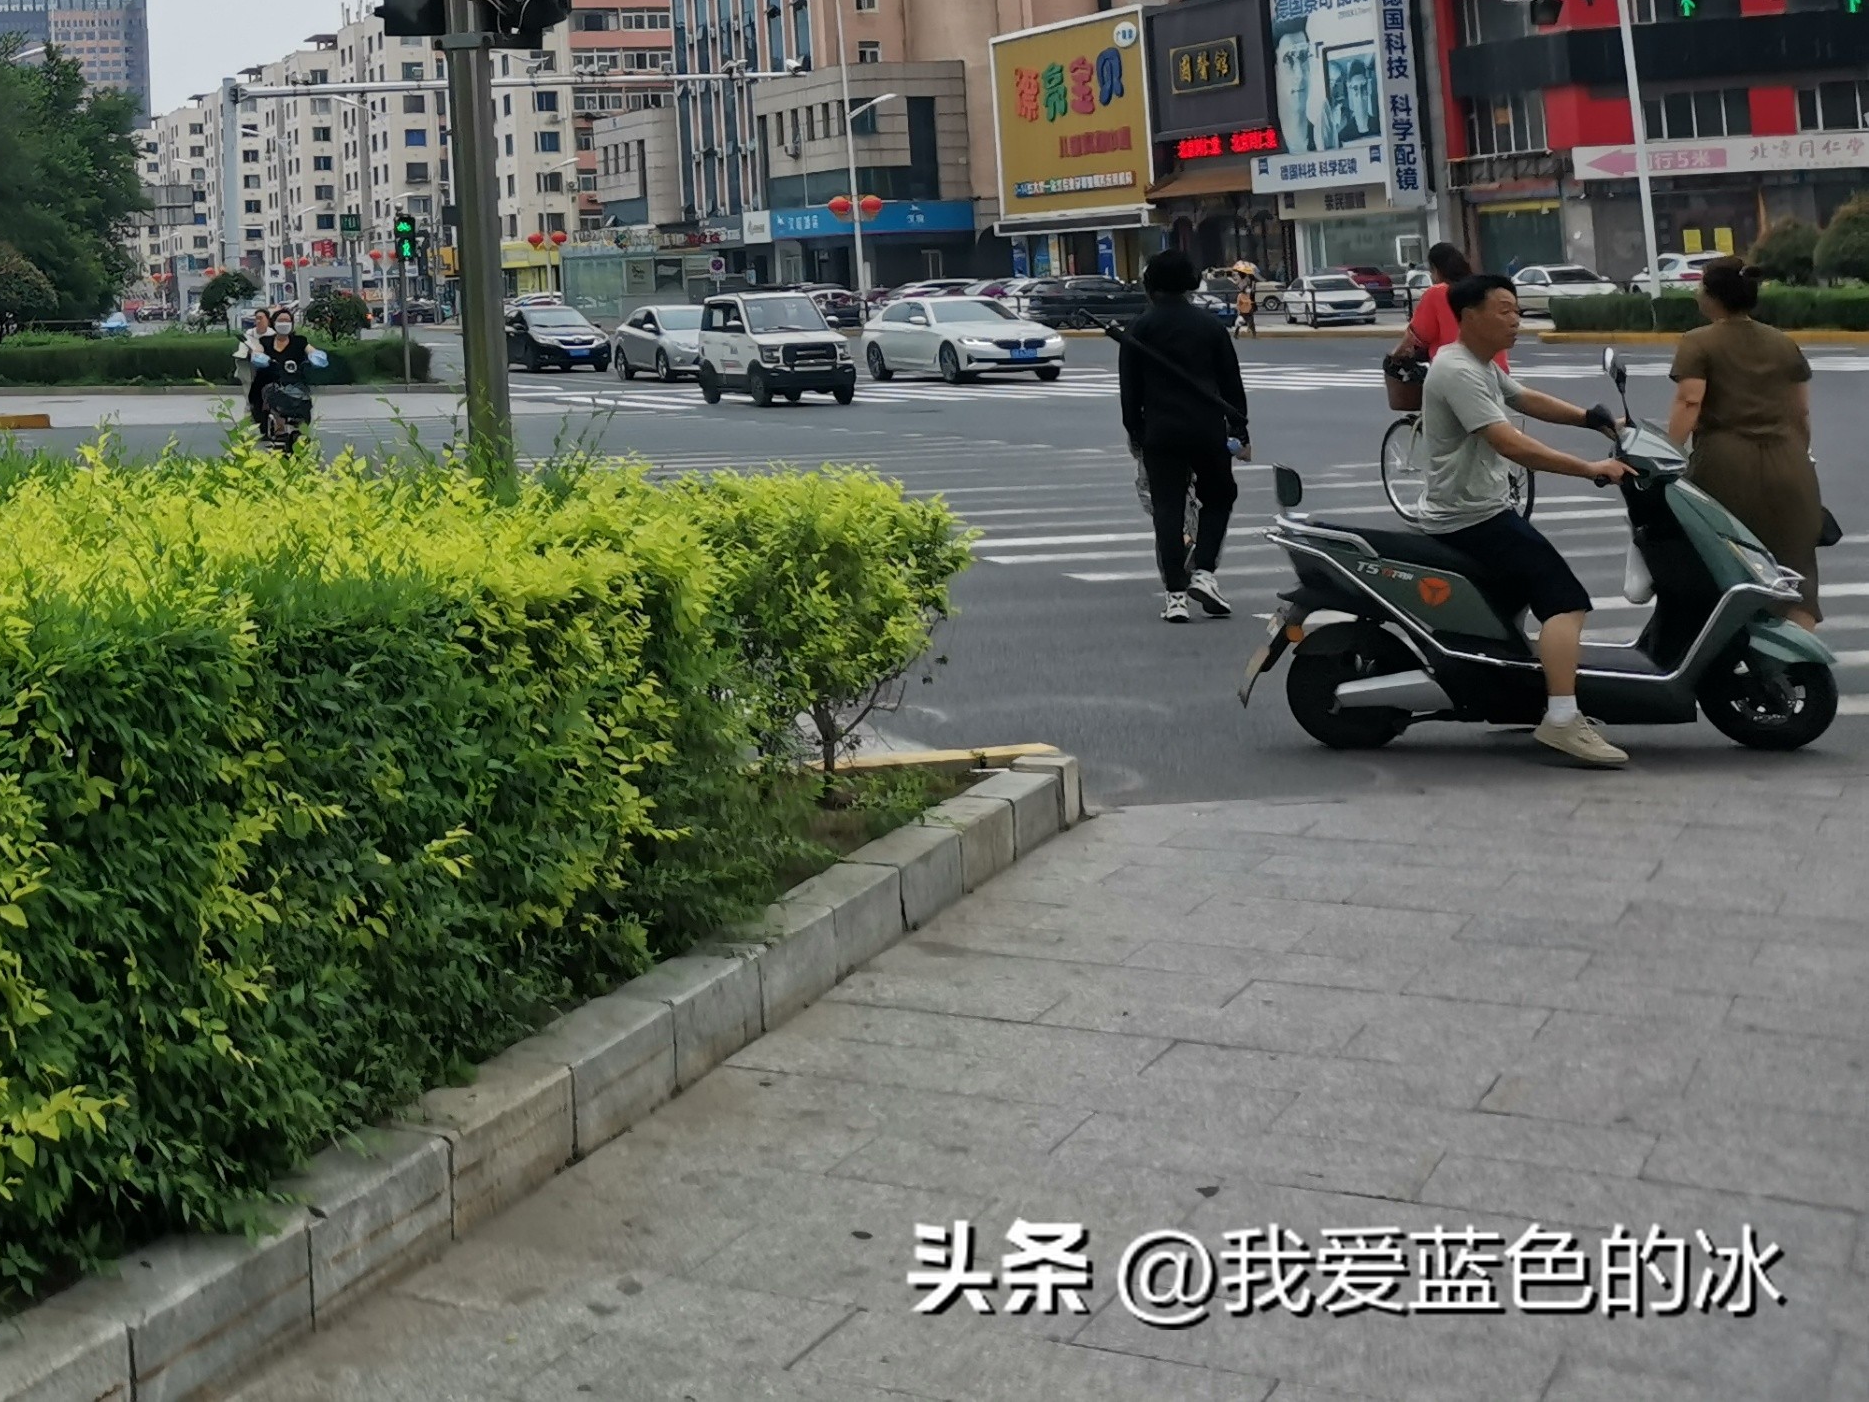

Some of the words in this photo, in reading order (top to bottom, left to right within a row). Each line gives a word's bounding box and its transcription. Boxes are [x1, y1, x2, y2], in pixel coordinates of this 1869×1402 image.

[1390, 94, 1420, 192] 科学配镜
[1750, 136, 1866, 162] 北京同仁堂
